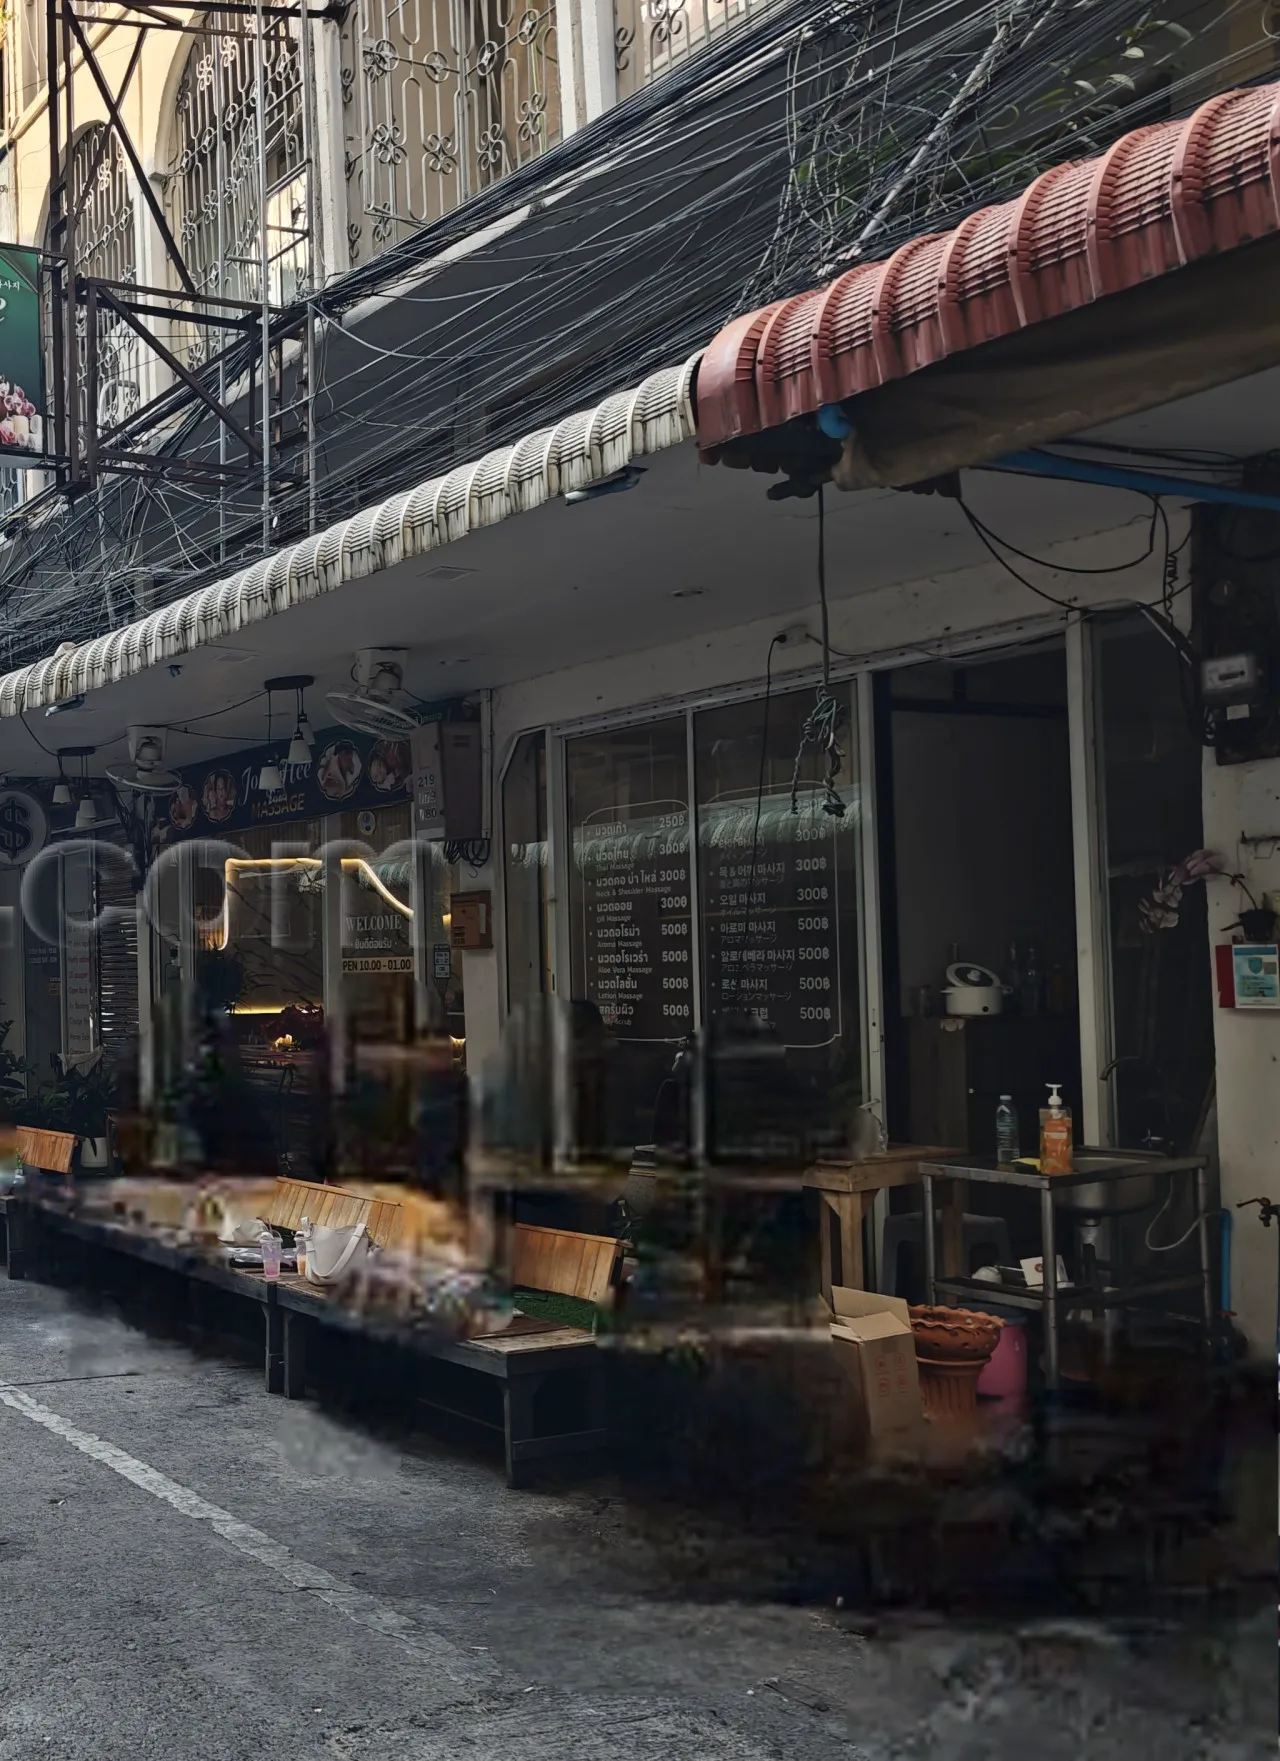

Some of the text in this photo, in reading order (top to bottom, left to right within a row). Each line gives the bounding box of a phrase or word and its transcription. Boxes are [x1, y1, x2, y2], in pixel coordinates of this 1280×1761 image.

[418, 774, 435, 787] 219
[610, 862, 635, 871] Massage
[757, 861, 786, 875] 마사지
[617, 887, 644, 895] Shoulder
[645, 886, 672, 894] Massage
[346, 914, 402, 931] WELCOME
[606, 914, 632, 923] Massage
[748, 920, 776, 933] 마사지
[617, 940, 643, 949] Massage
[766, 948, 795, 961] 마사지
[342, 959, 411, 971] PEN 10.00 01.00
[598, 966, 653, 974] Aloe Vera Massage
[740, 978, 768, 991] 마사지
[617, 992, 643, 1001] Massage
